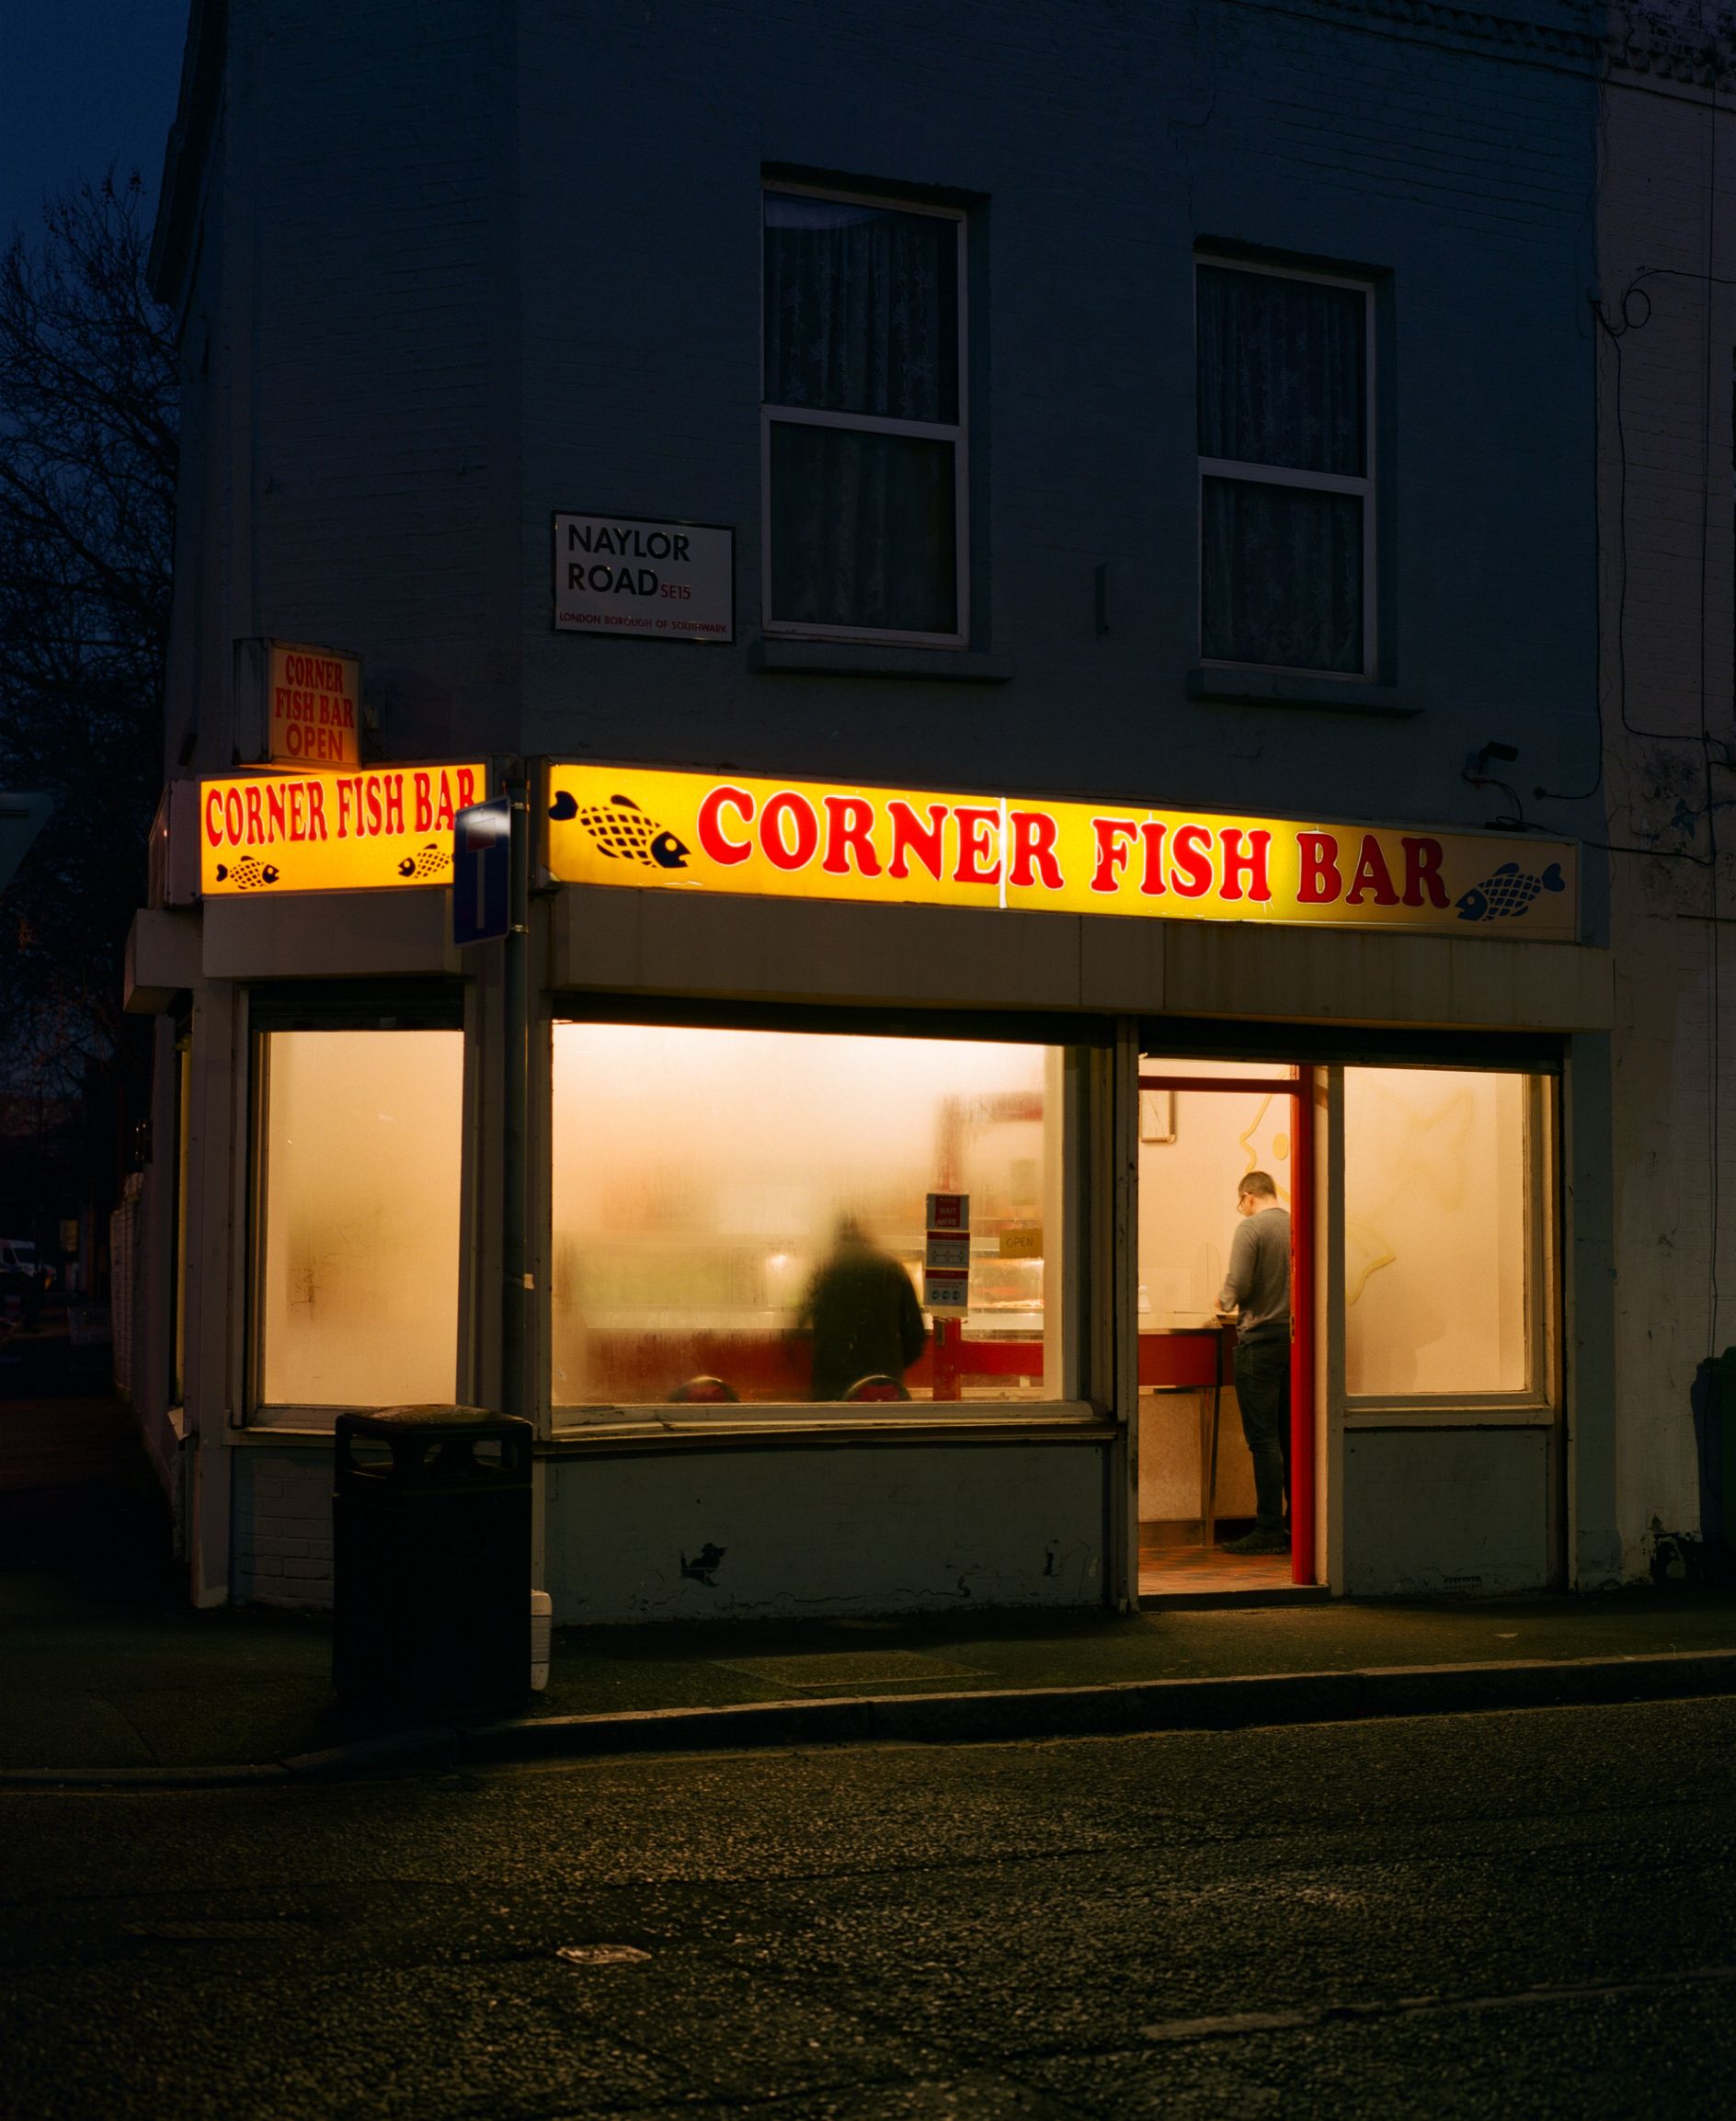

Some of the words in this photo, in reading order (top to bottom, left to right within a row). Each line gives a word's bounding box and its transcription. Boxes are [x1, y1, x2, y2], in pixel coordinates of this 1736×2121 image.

[568, 524, 691, 562] NAYLOR
[568, 563, 658, 597] ROAD
[661, 584, 691, 600] SE15
[559, 612, 600, 624] LONDON
[604, 616, 652, 627] BOROUGH
[656, 620, 668, 629] OF
[671, 621, 727, 633] SOUTHWARK
[285, 654, 343, 694] CORNER
[275, 687, 314, 723] FISH
[319, 694, 355, 729] BAR
[286, 723, 343, 761] OPEN
[206, 779, 327, 848] CORNER
[337, 773, 405, 838] FISH
[414, 768, 475, 832] BAR
[697, 785, 1065, 890] CORNER
[1090, 816, 1273, 902] FISH
[1296, 831, 1451, 909] BAR
[939, 1206, 956, 1214] WAIT
[1006, 1237, 1034, 1249] OPEN
